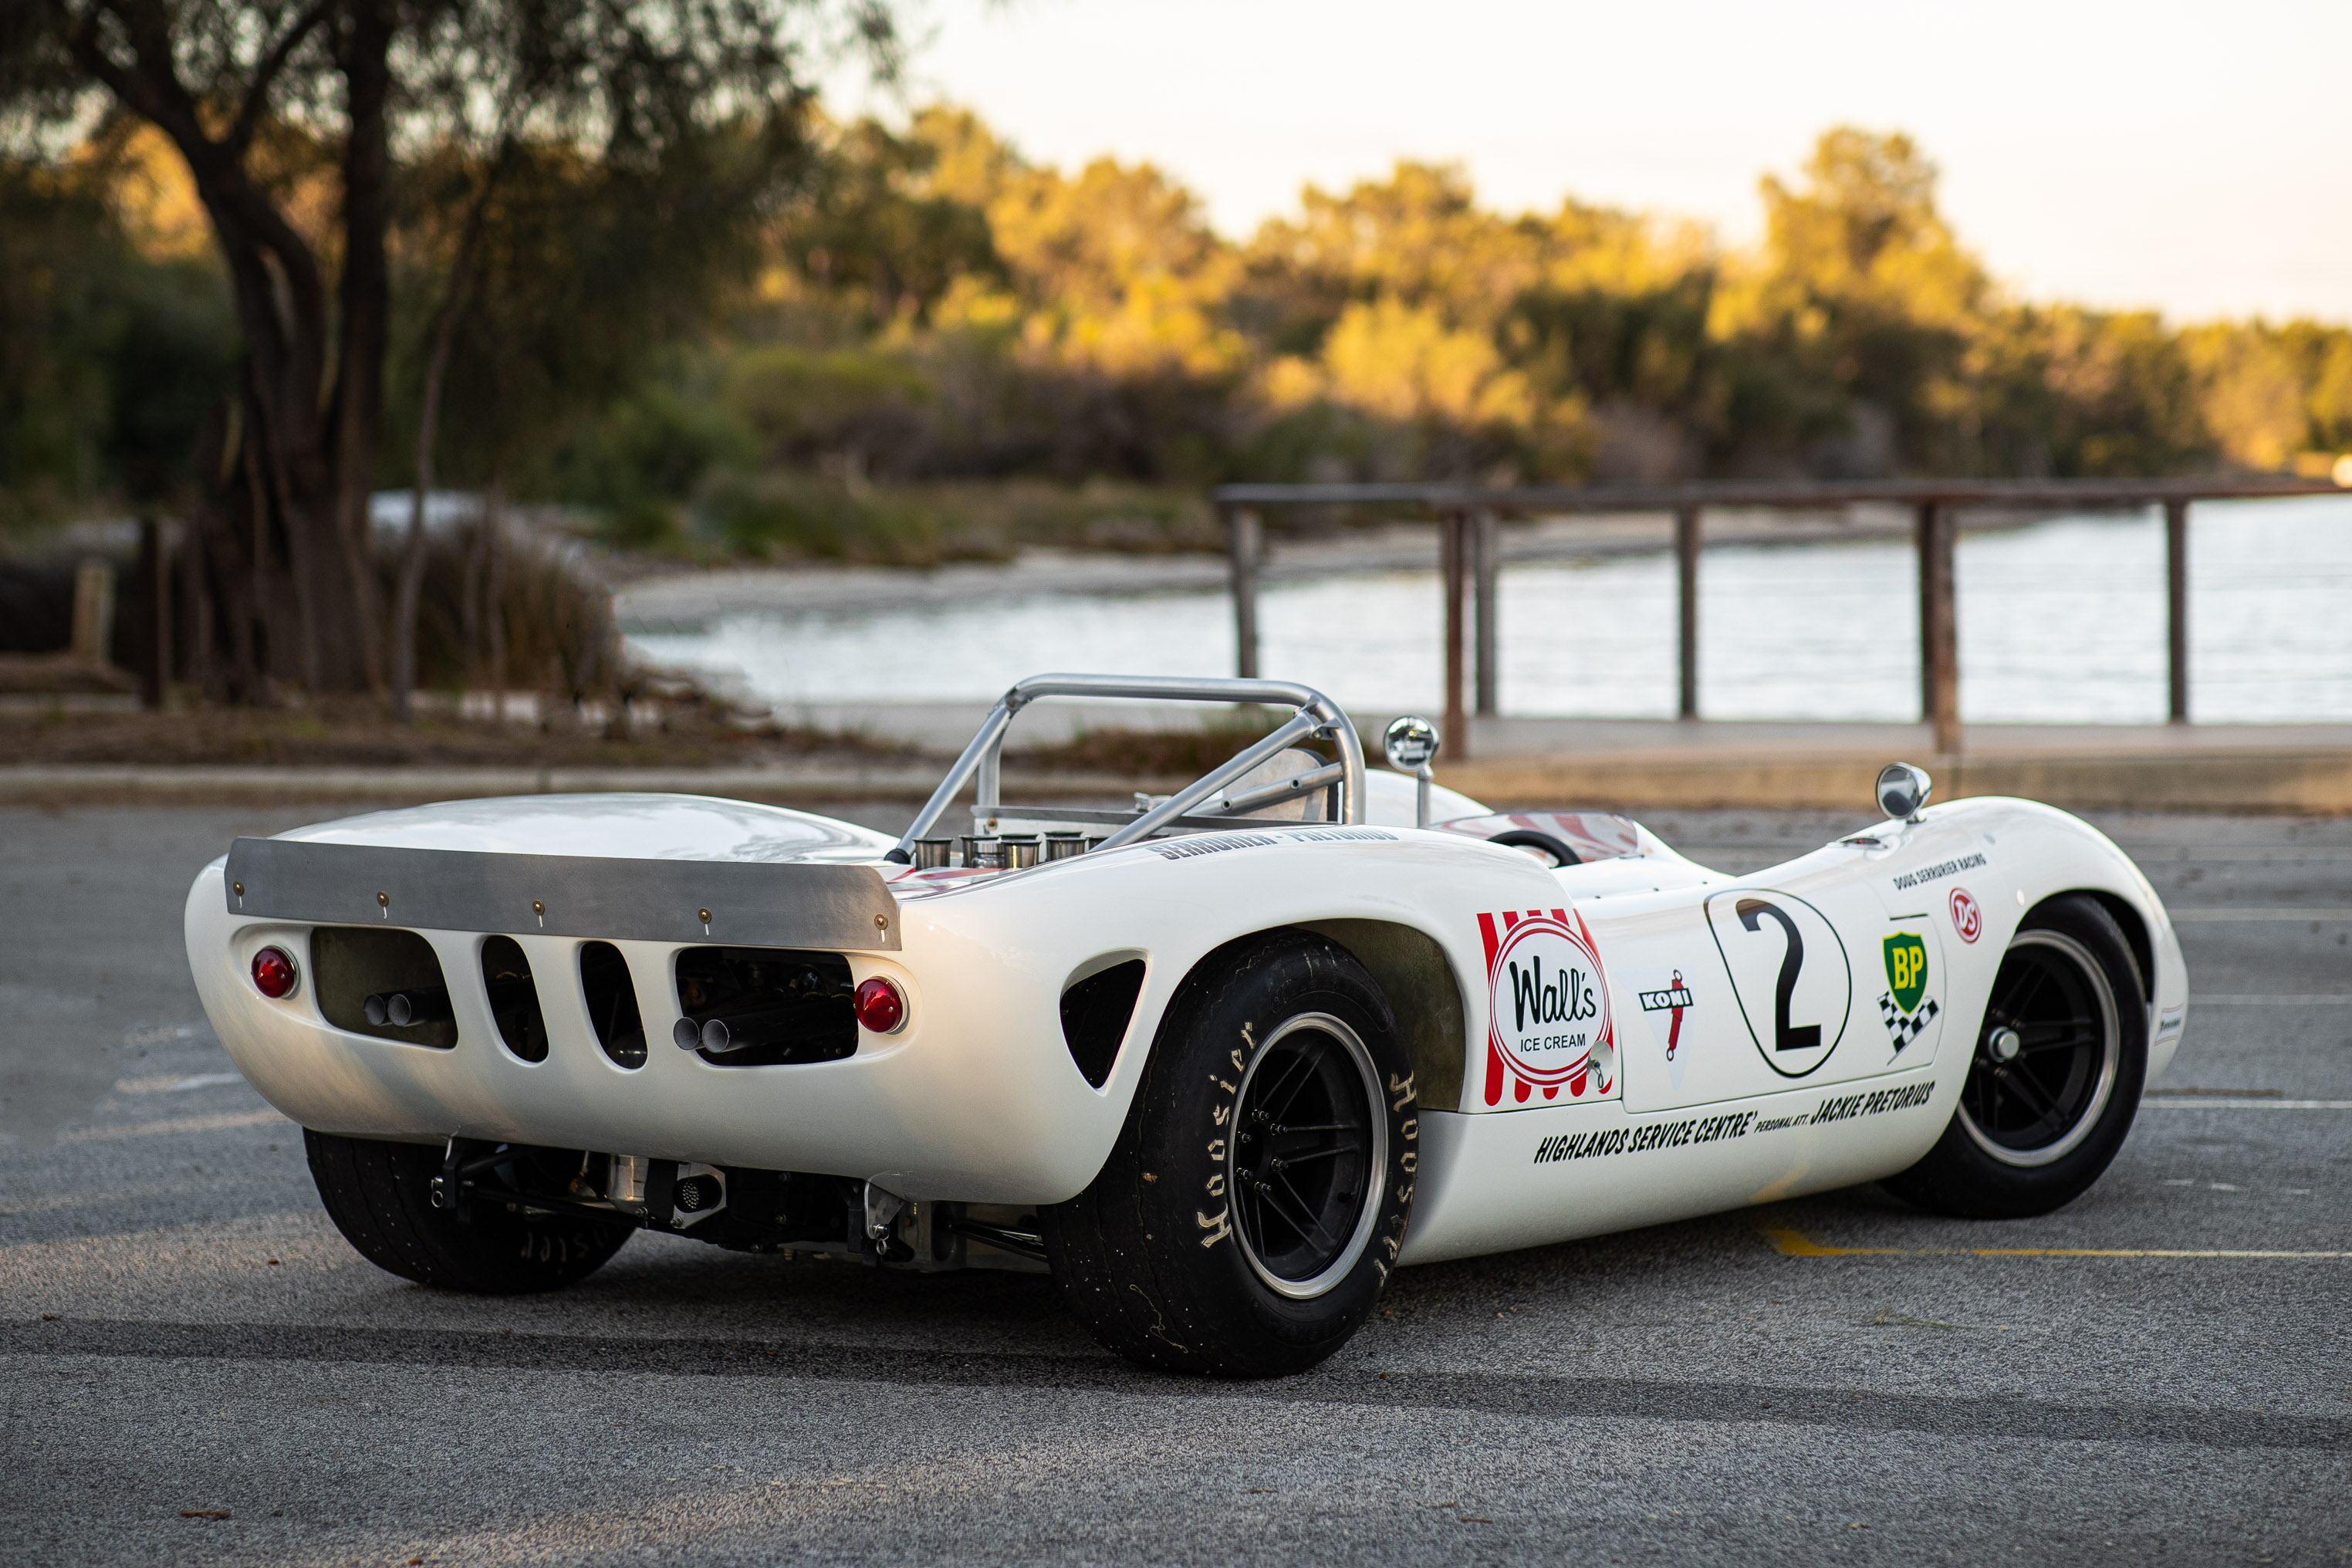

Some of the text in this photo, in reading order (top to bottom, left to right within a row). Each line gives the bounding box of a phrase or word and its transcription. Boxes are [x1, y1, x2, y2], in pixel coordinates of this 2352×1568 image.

[1893, 853, 1986, 890] DOUG SERRURIER RACING
[1955, 900, 1978, 932] DS
[1735, 898, 1821, 1052] 2
[1892, 945, 1924, 989] BP
[1509, 955, 1597, 1032] Wall's
[1641, 989, 1691, 1009] KONI
[1520, 1033, 1586, 1053] ICE CREAM
[1196, 1022, 1256, 1249] Hoosier
[1534, 1127, 1630, 1164] HIGHLANDS
[1627, 1119, 1696, 1153] SERVICE
[1754, 1116, 1793, 1134] PERSONAL
[1792, 1113, 1809, 1127] ATT.
[1810, 1093, 1866, 1126] JACKIE
[1860, 1080, 1935, 1117] PRETORIUS
